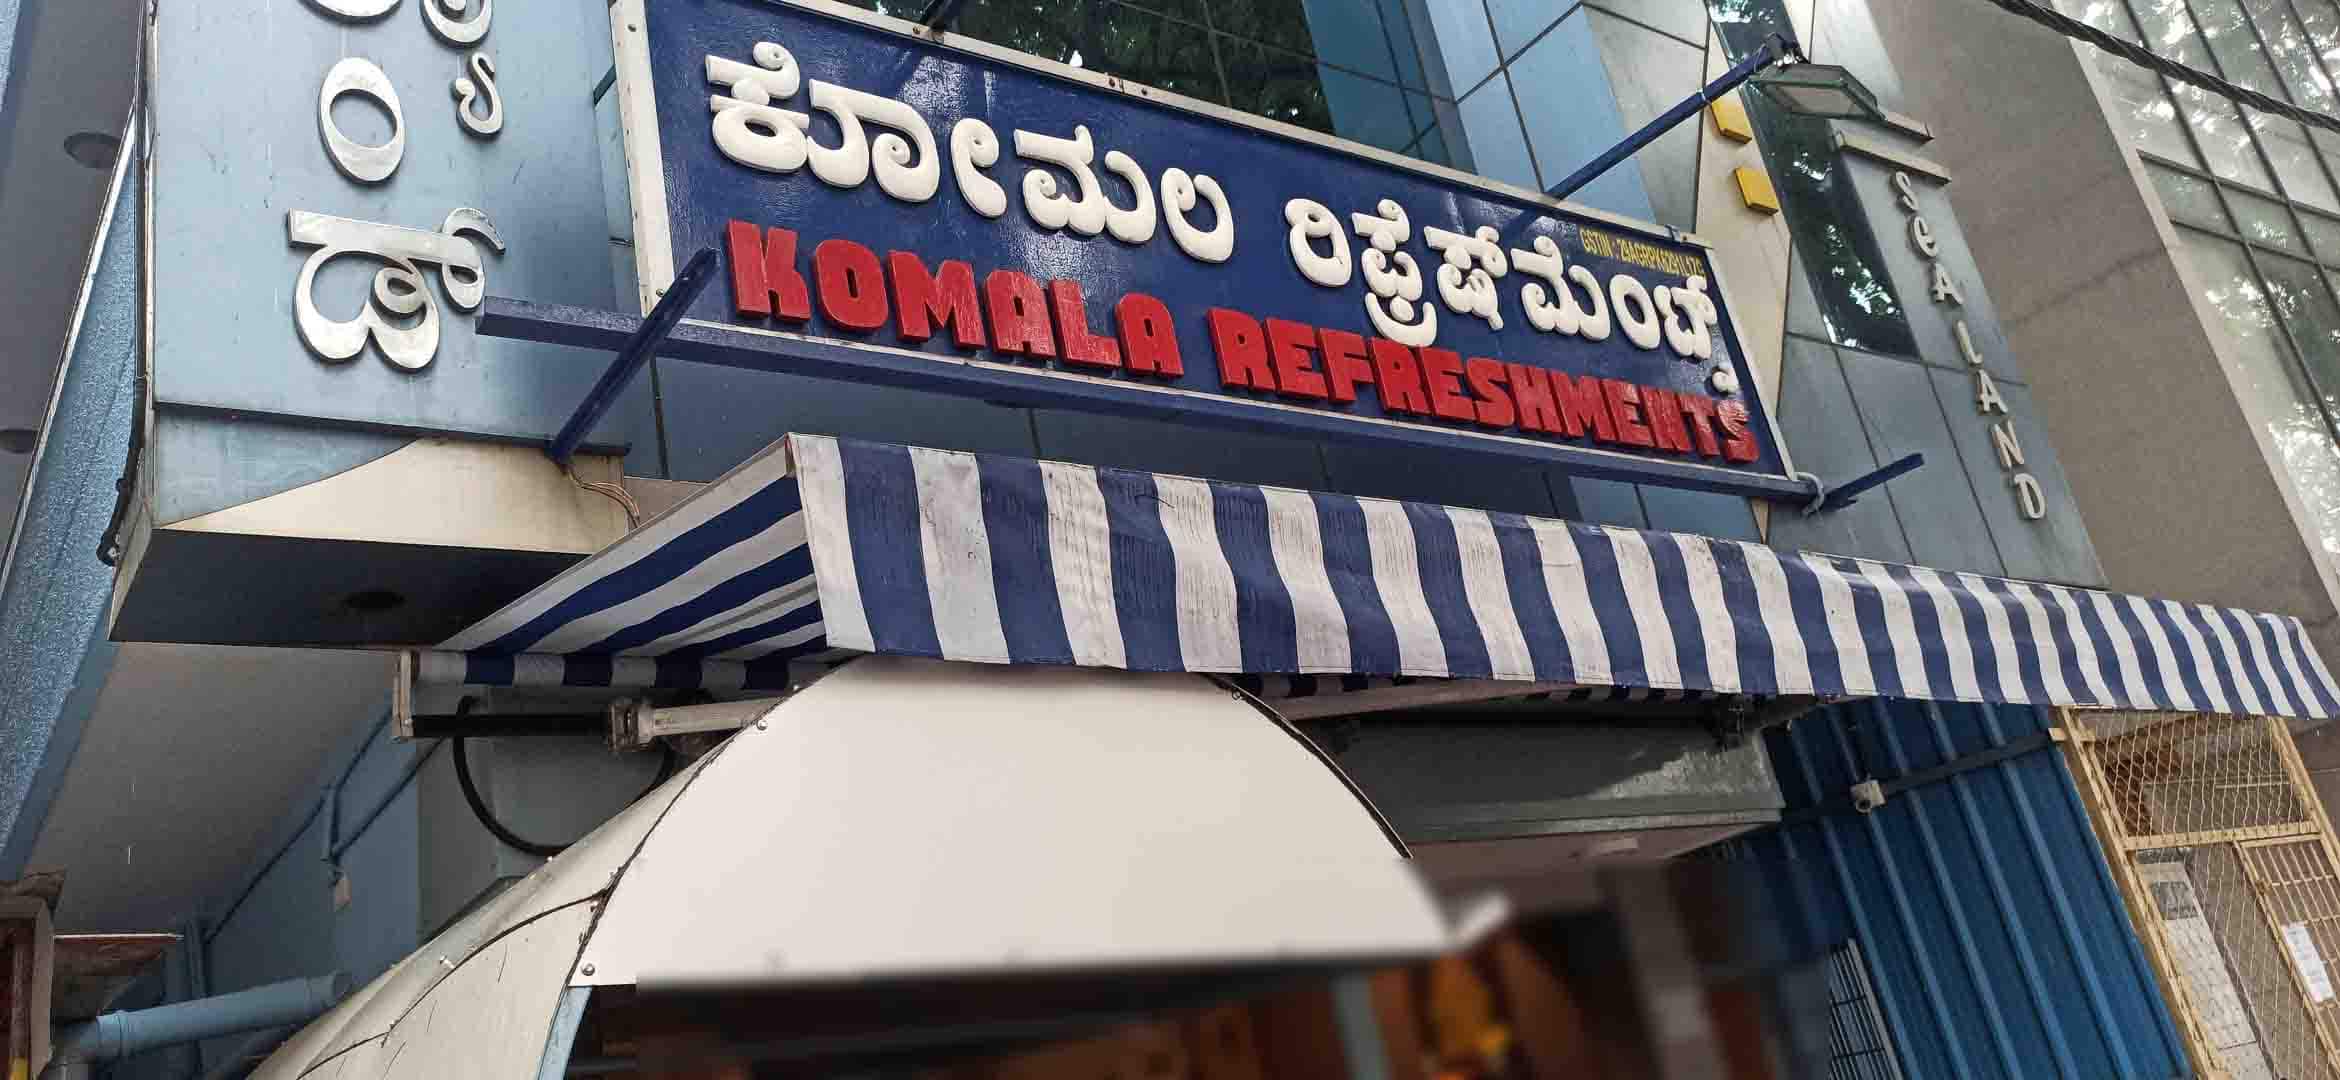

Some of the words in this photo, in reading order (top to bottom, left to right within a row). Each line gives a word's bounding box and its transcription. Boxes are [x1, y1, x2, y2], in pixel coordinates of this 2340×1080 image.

[705, 41, 1235, 264] ಕೋಮಲ
[1580, 228, 1612, 257] GSTIN
[726, 218, 1185, 379] KOMALA
[1207, 306, 1761, 464] REFRESHMENTS
